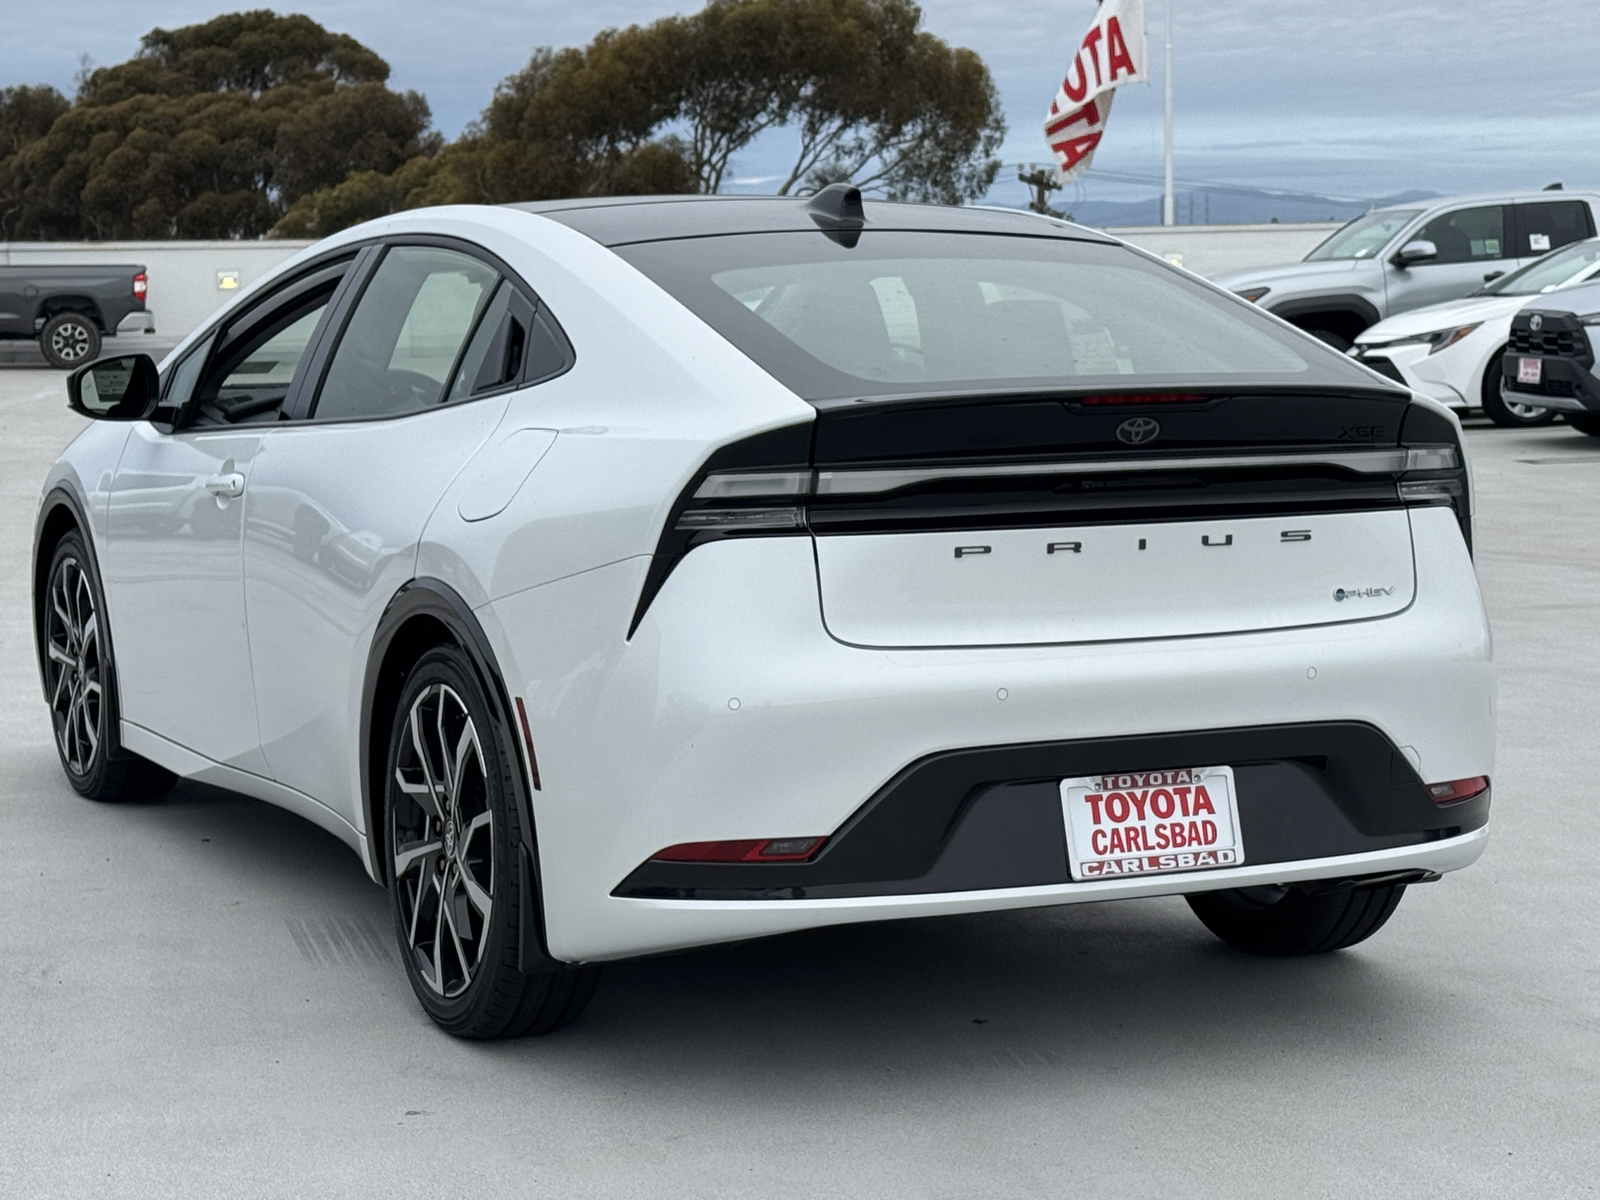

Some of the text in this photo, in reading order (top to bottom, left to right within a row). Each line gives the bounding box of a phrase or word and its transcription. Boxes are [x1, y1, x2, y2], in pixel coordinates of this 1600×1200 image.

[1338, 425, 1386, 439] XSE
[954, 529, 1312, 558] PRIUS
[1104, 770, 1191, 789] TOYOTA
[1085, 785, 1216, 825] TOYOTA
[1092, 820, 1217, 855] CARLSBAD
[1081, 850, 1235, 876] CARLSBAD
